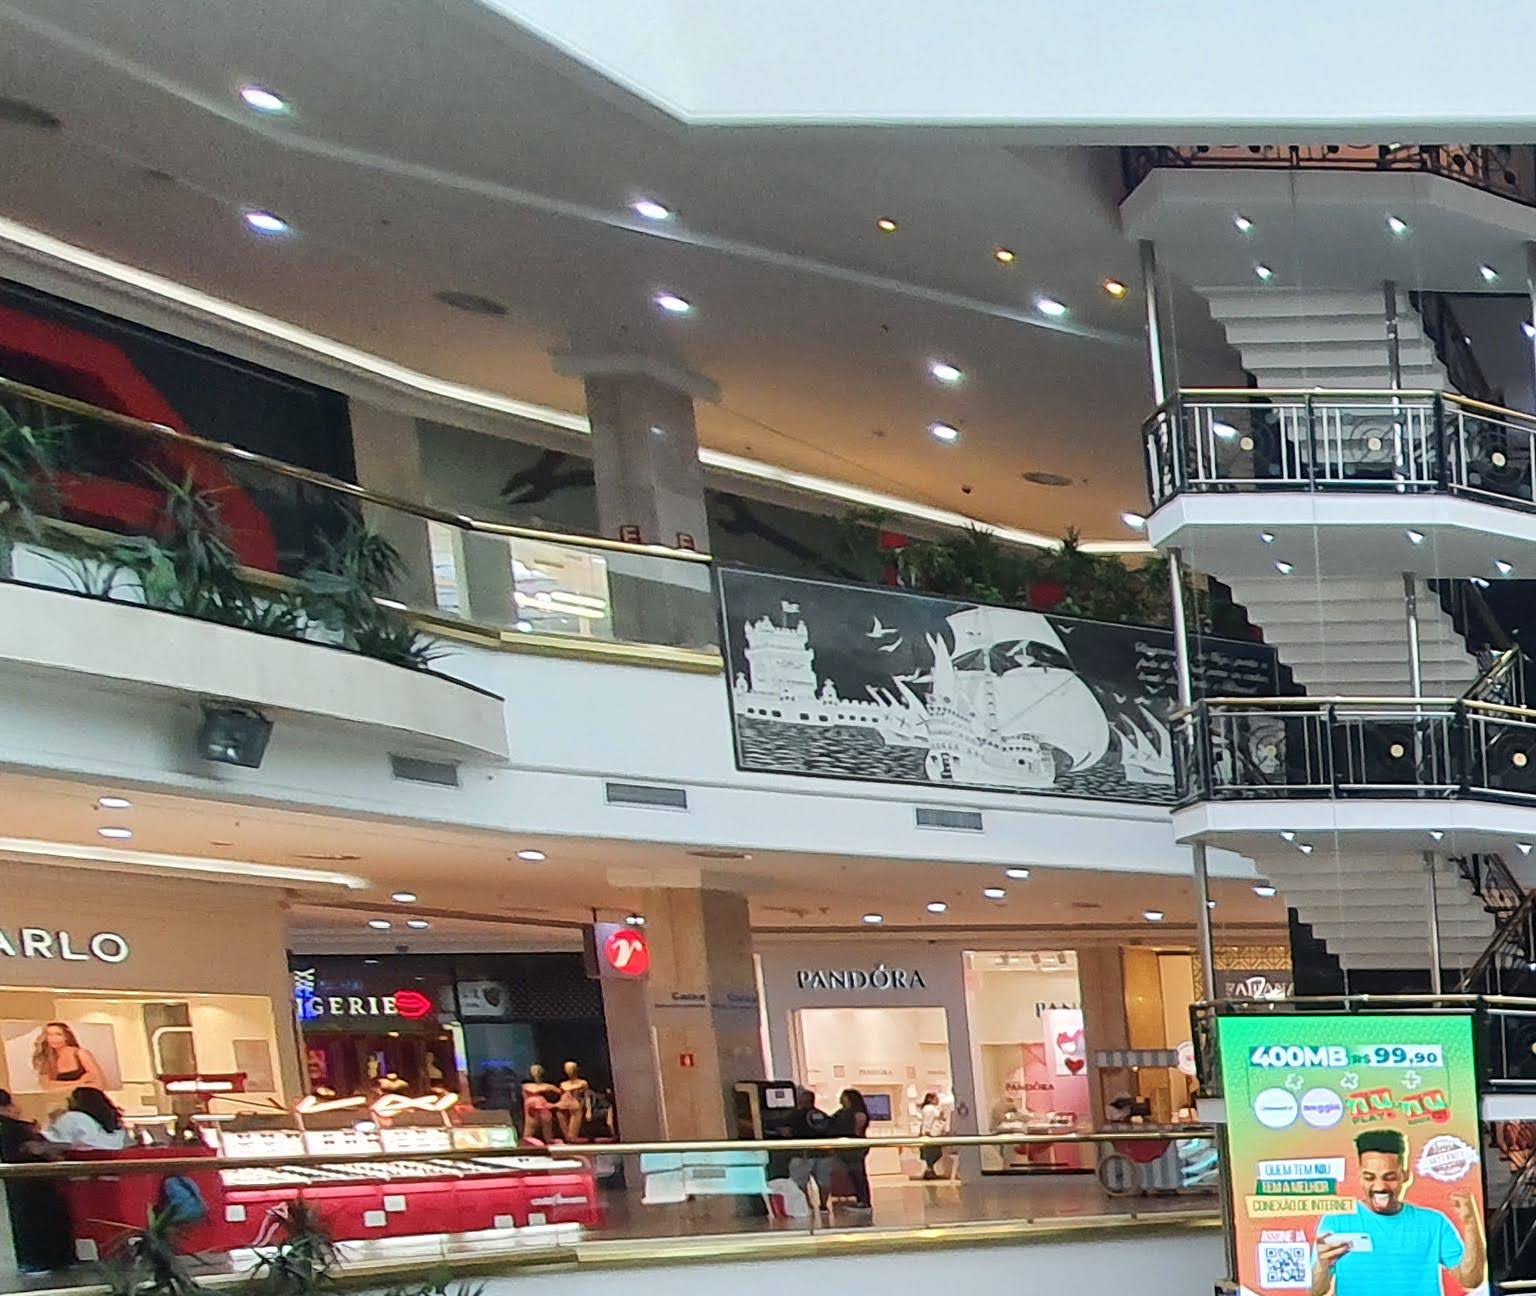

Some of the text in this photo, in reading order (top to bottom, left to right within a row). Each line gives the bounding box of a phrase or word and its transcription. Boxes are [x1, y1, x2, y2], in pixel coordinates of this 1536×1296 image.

[797, 965, 926, 990] PANDORA
[1251, 1046, 1348, 1068] 400MB
[1374, 1047, 1437, 1065] 99,90
